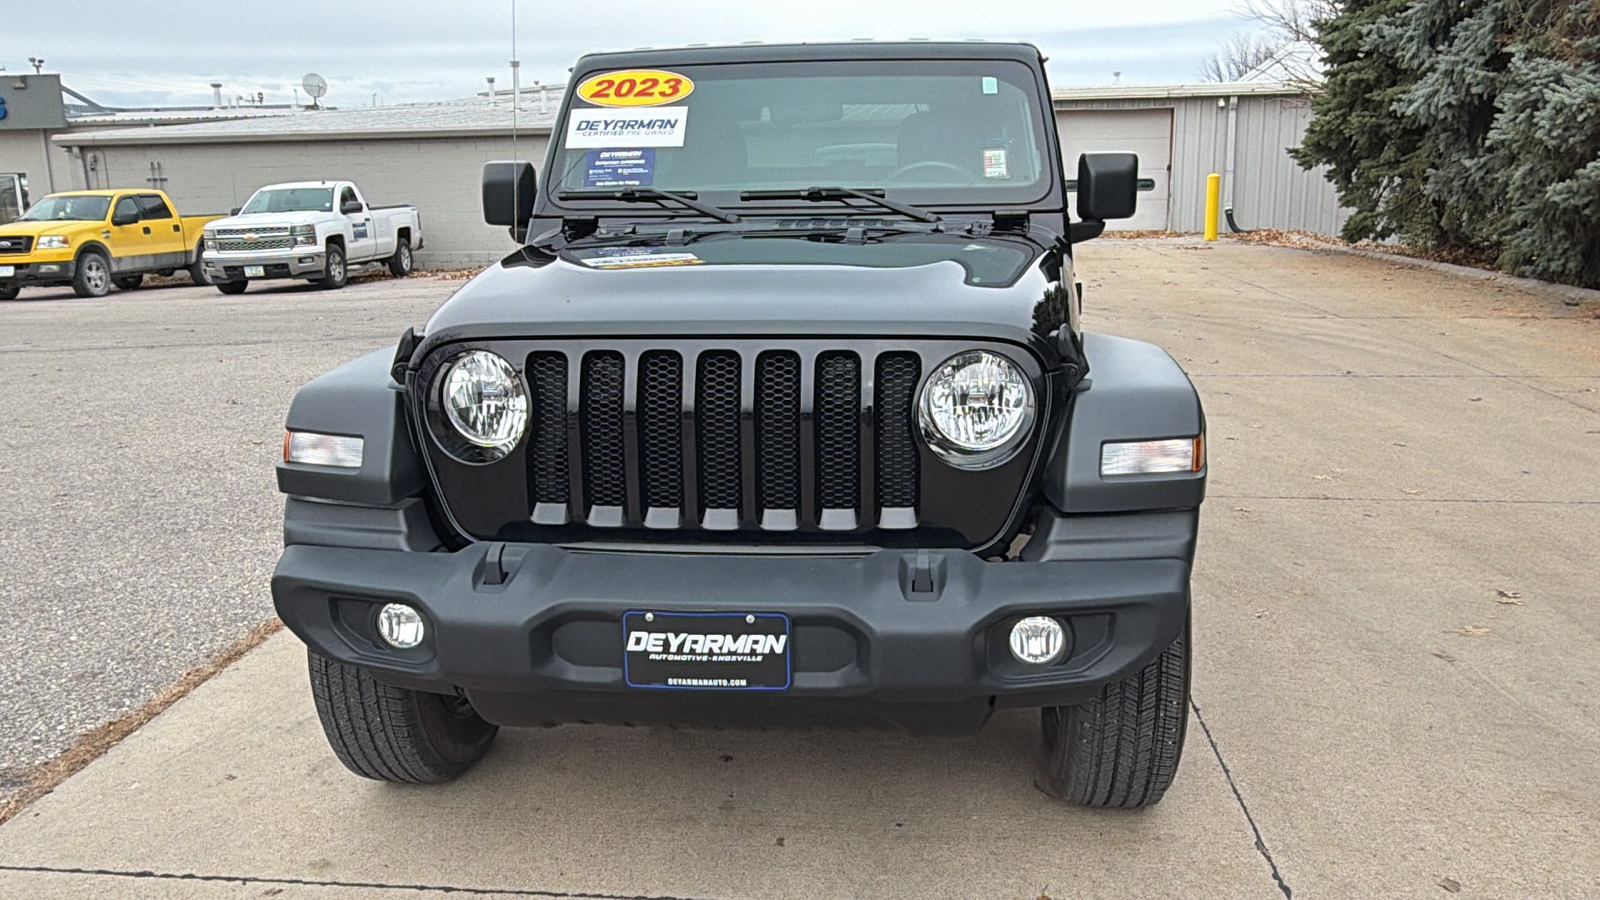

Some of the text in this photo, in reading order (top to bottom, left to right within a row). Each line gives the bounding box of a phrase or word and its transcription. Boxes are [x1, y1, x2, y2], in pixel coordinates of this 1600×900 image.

[589, 78, 683, 98] 2023
[576, 119, 678, 131] DEYARMAN
[626, 631, 787, 654] DEYARMAN
[667, 678, 747, 687] DEYARMANAUTO.COM
